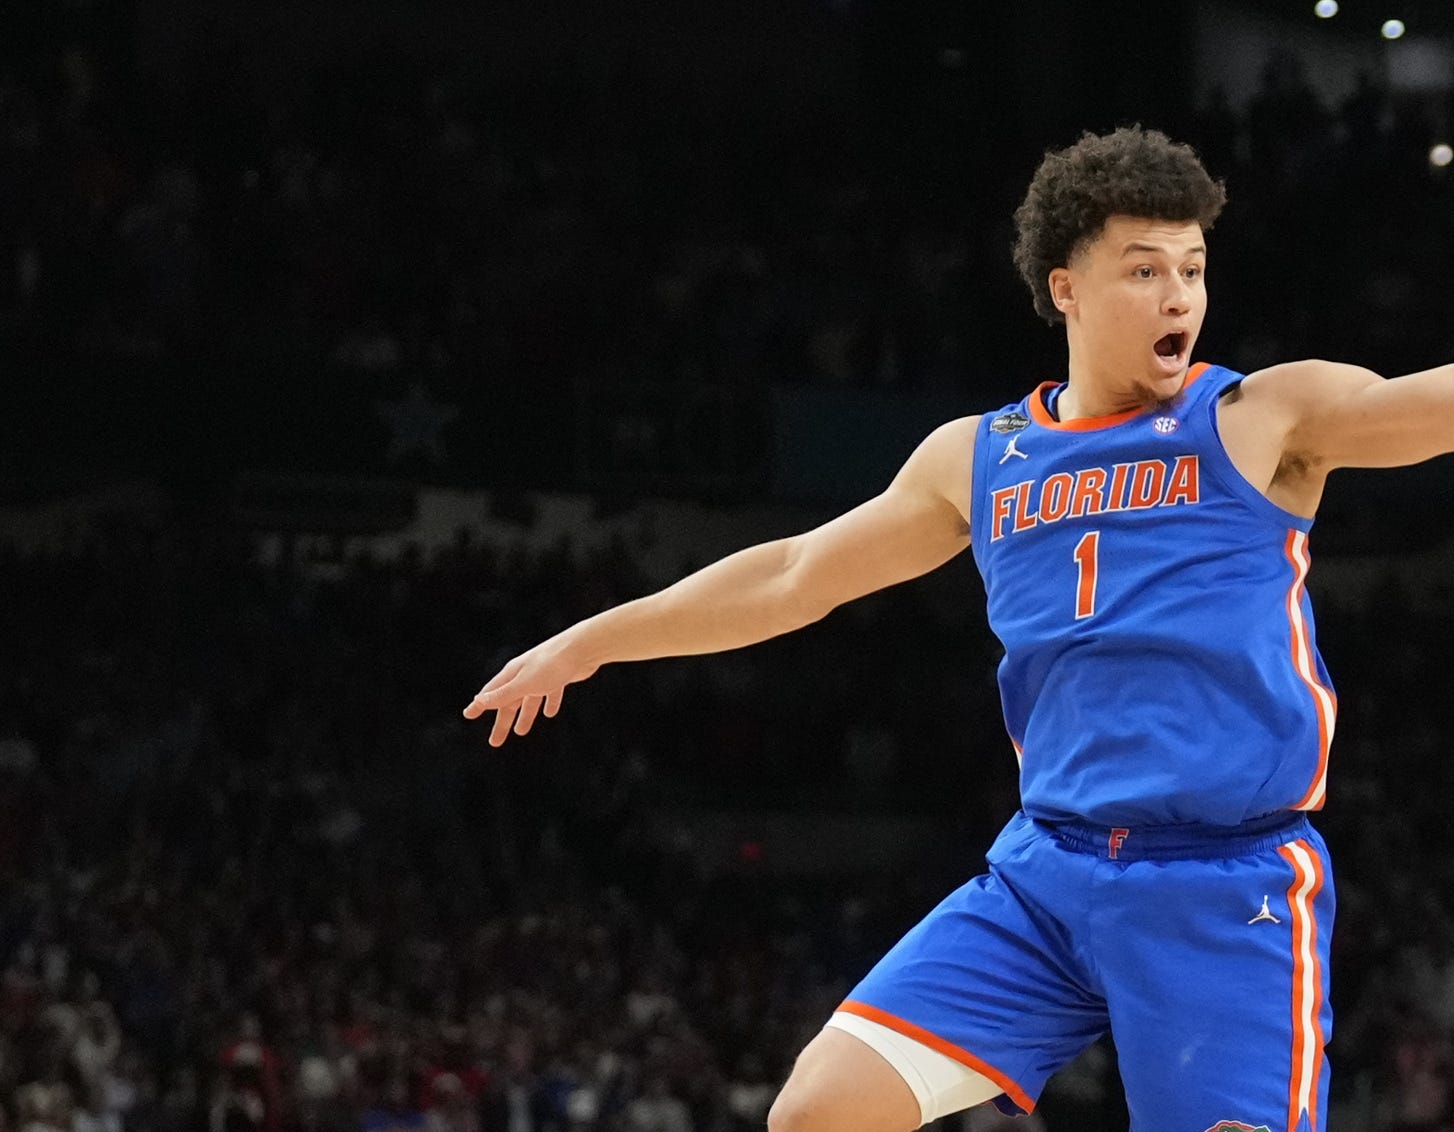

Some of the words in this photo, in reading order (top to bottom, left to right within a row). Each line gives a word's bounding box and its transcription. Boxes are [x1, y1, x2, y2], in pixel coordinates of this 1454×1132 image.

[1154, 416, 1177, 433] SEC
[990, 454, 1200, 544] FLORIDA
[1073, 530, 1100, 621] 1
[1108, 827, 1130, 860] F
